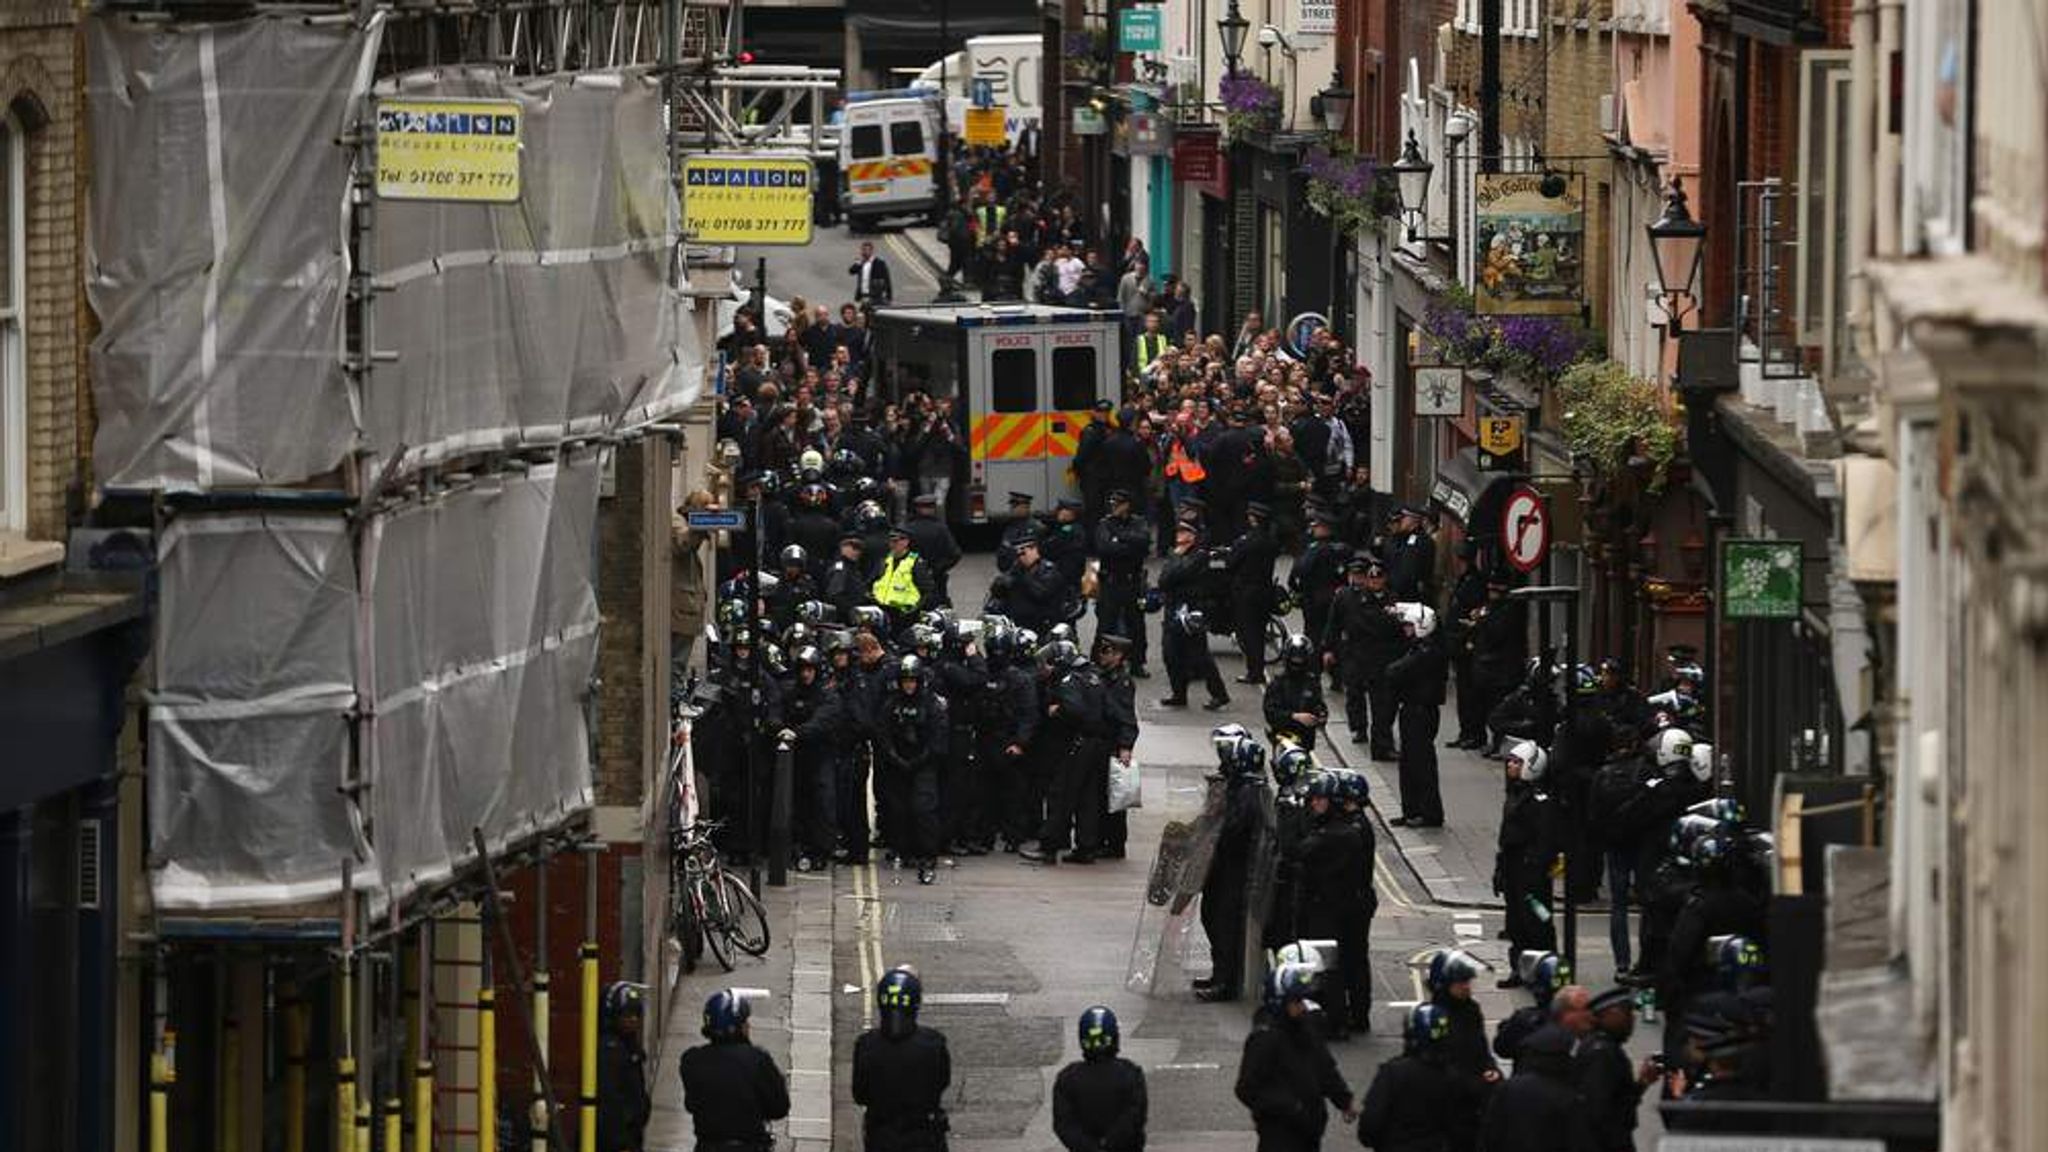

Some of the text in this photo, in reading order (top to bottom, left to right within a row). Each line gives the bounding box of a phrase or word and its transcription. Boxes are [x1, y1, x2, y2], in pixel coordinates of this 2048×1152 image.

[689, 170, 805, 185] AVALON
[756, 218, 779, 231] 371
[783, 219, 806, 231] 777
[996, 334, 1091, 346] POLICE POLICE
